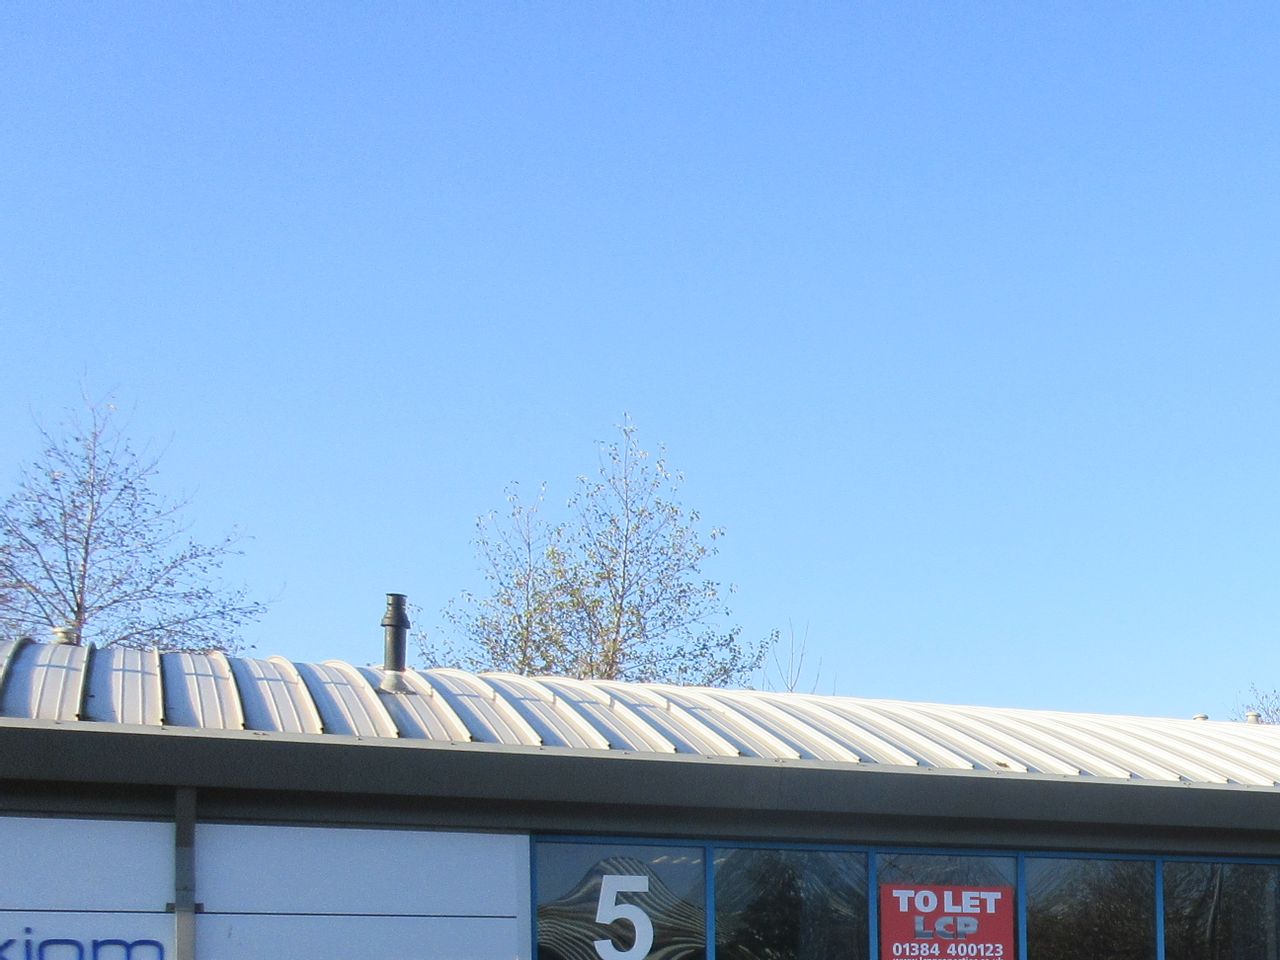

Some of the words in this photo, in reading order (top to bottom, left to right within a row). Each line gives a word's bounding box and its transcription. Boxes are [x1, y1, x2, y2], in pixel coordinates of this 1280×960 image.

[892, 889, 938, 913] TO
[943, 890, 1002, 914] LET
[914, 915, 979, 940] LCP
[892, 942, 940, 956] 01384
[946, 942, 1004, 957] 400123
